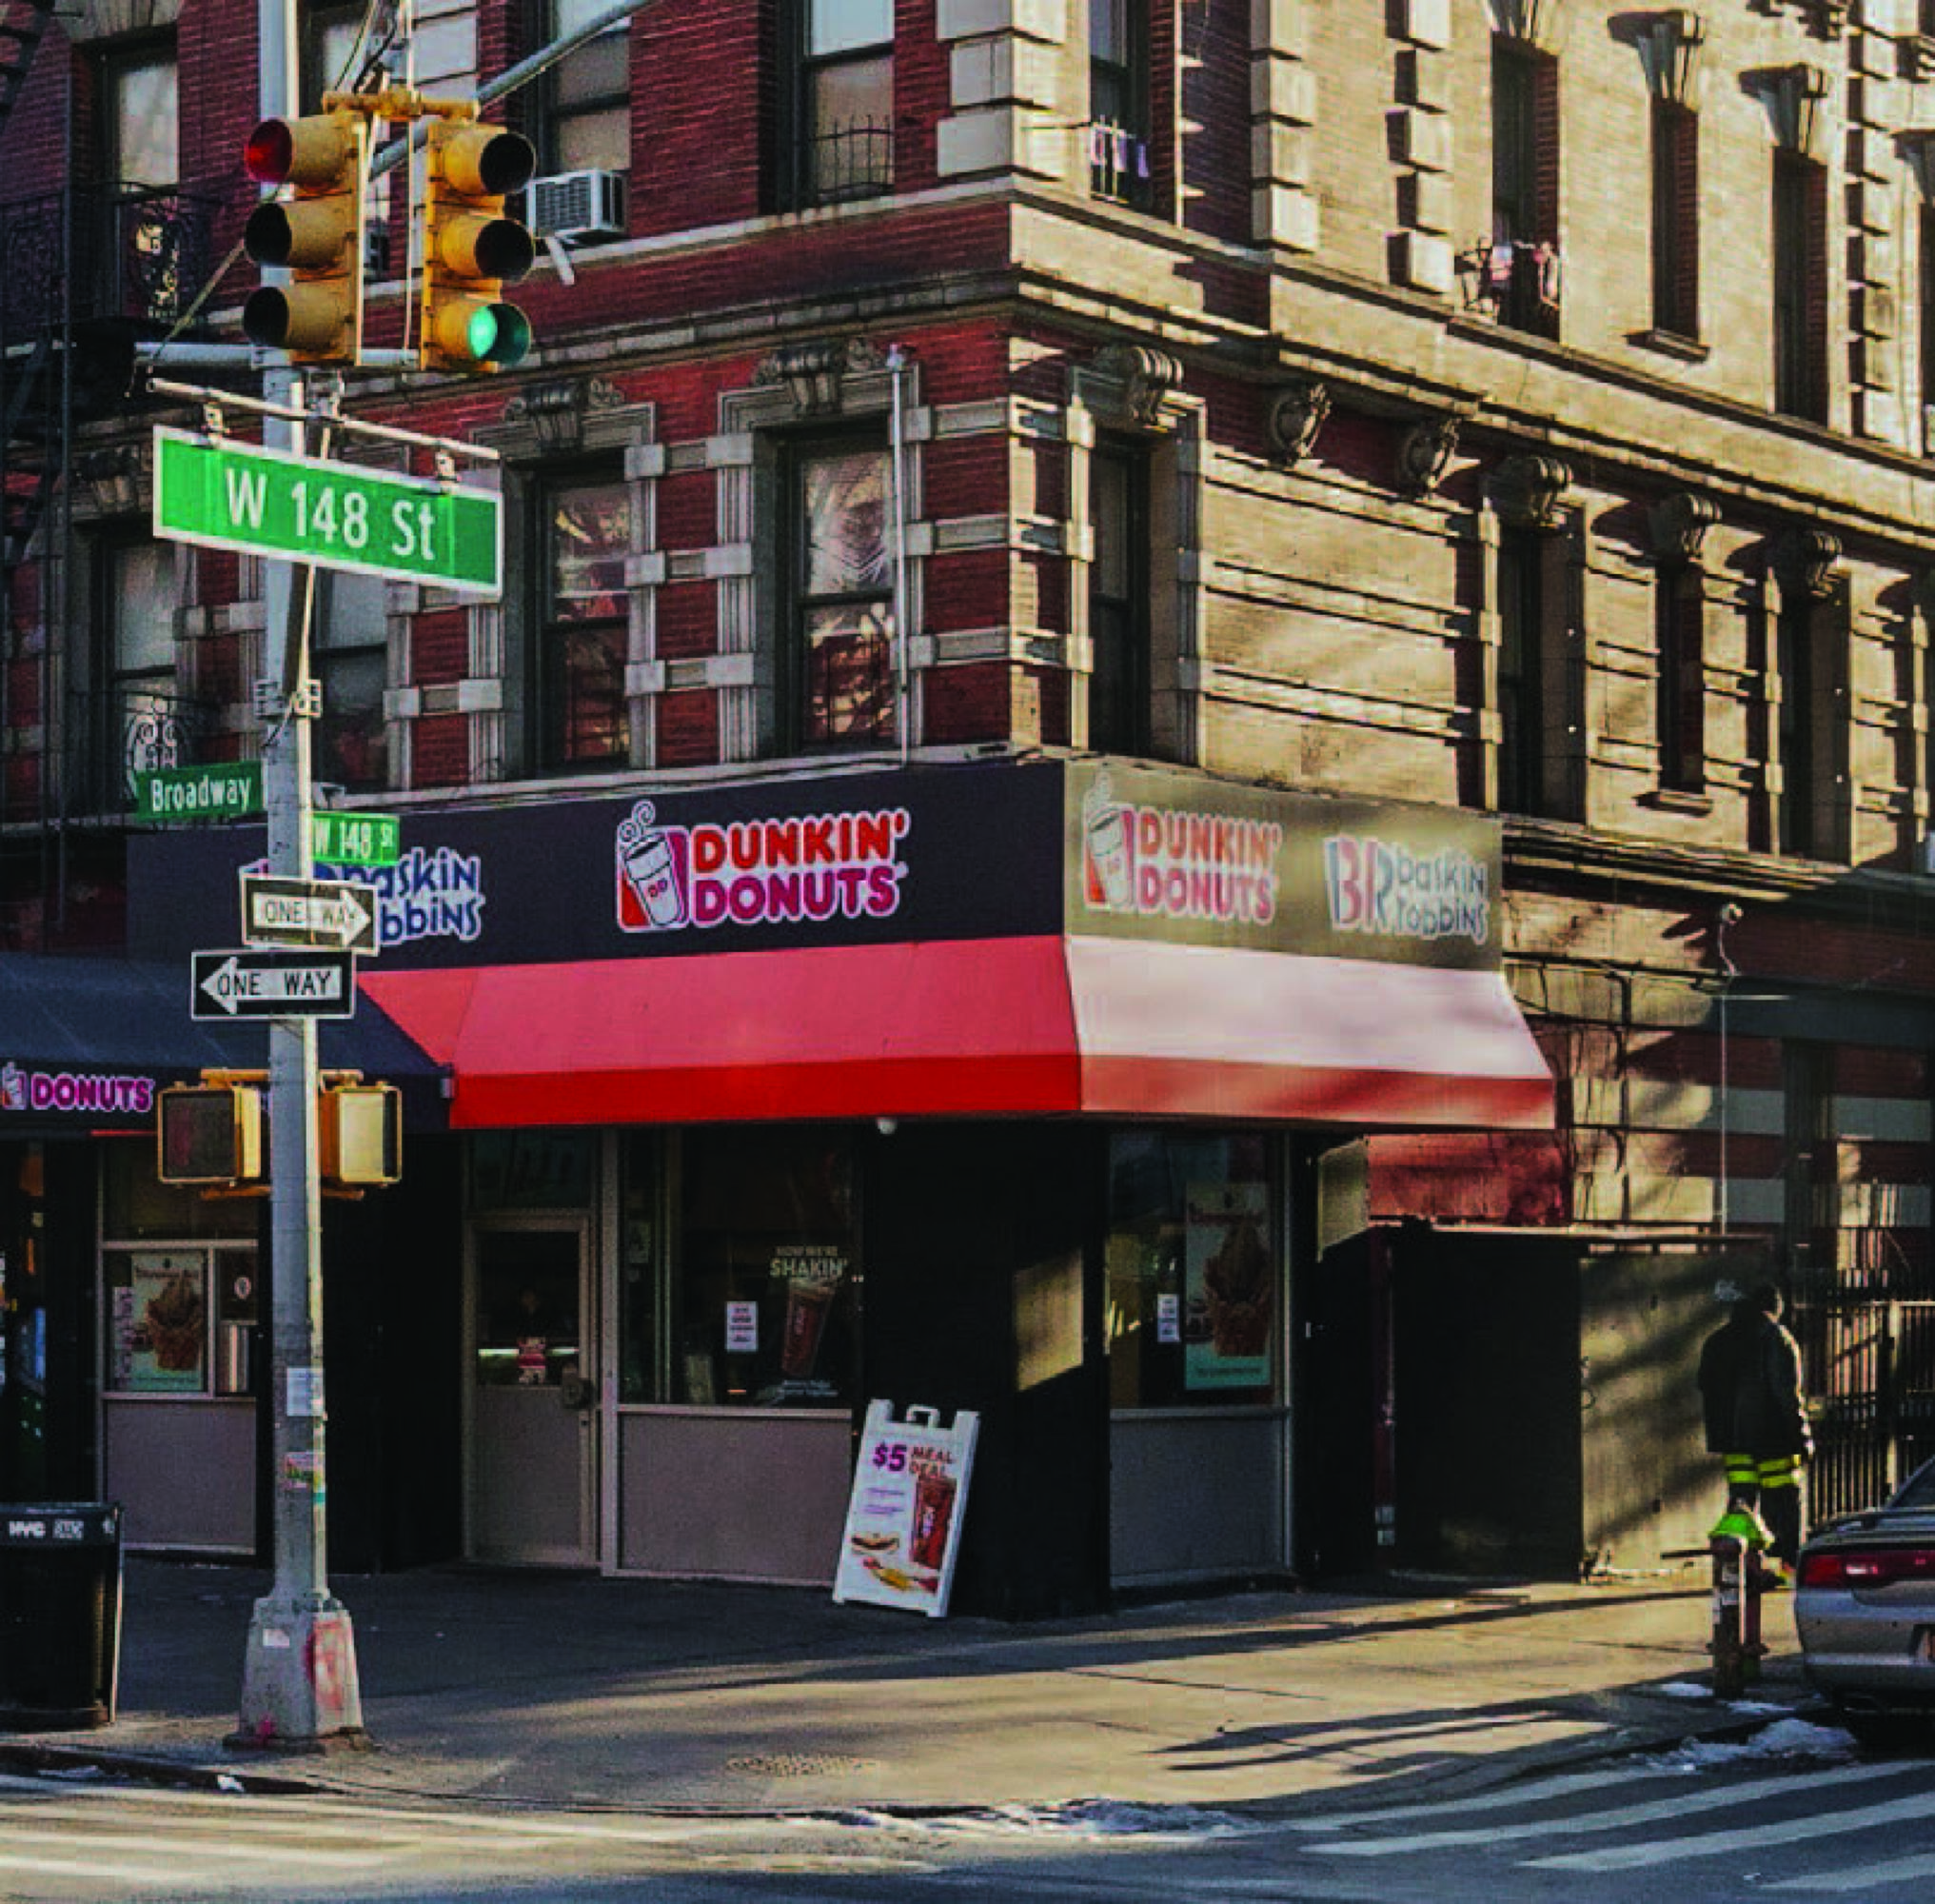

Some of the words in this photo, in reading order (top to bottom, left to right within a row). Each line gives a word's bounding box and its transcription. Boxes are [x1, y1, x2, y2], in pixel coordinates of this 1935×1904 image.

[227, 468, 267, 528] W
[291, 481, 368, 548] 148
[391, 501, 436, 560] St
[151, 775, 251, 811] Broadway
[316, 820, 331, 855] W
[339, 822, 372, 858] 148
[693, 810, 906, 873] DUNKIN'
[694, 865, 900, 923] DONUTS
[1140, 864, 1274, 920] DONUTS
[265, 900, 305, 923] ONE
[217, 972, 261, 998] ONE
[284, 972, 331, 997] WAY
[32, 1074, 151, 1112] DONUTS
[872, 1440, 907, 1472] $5
